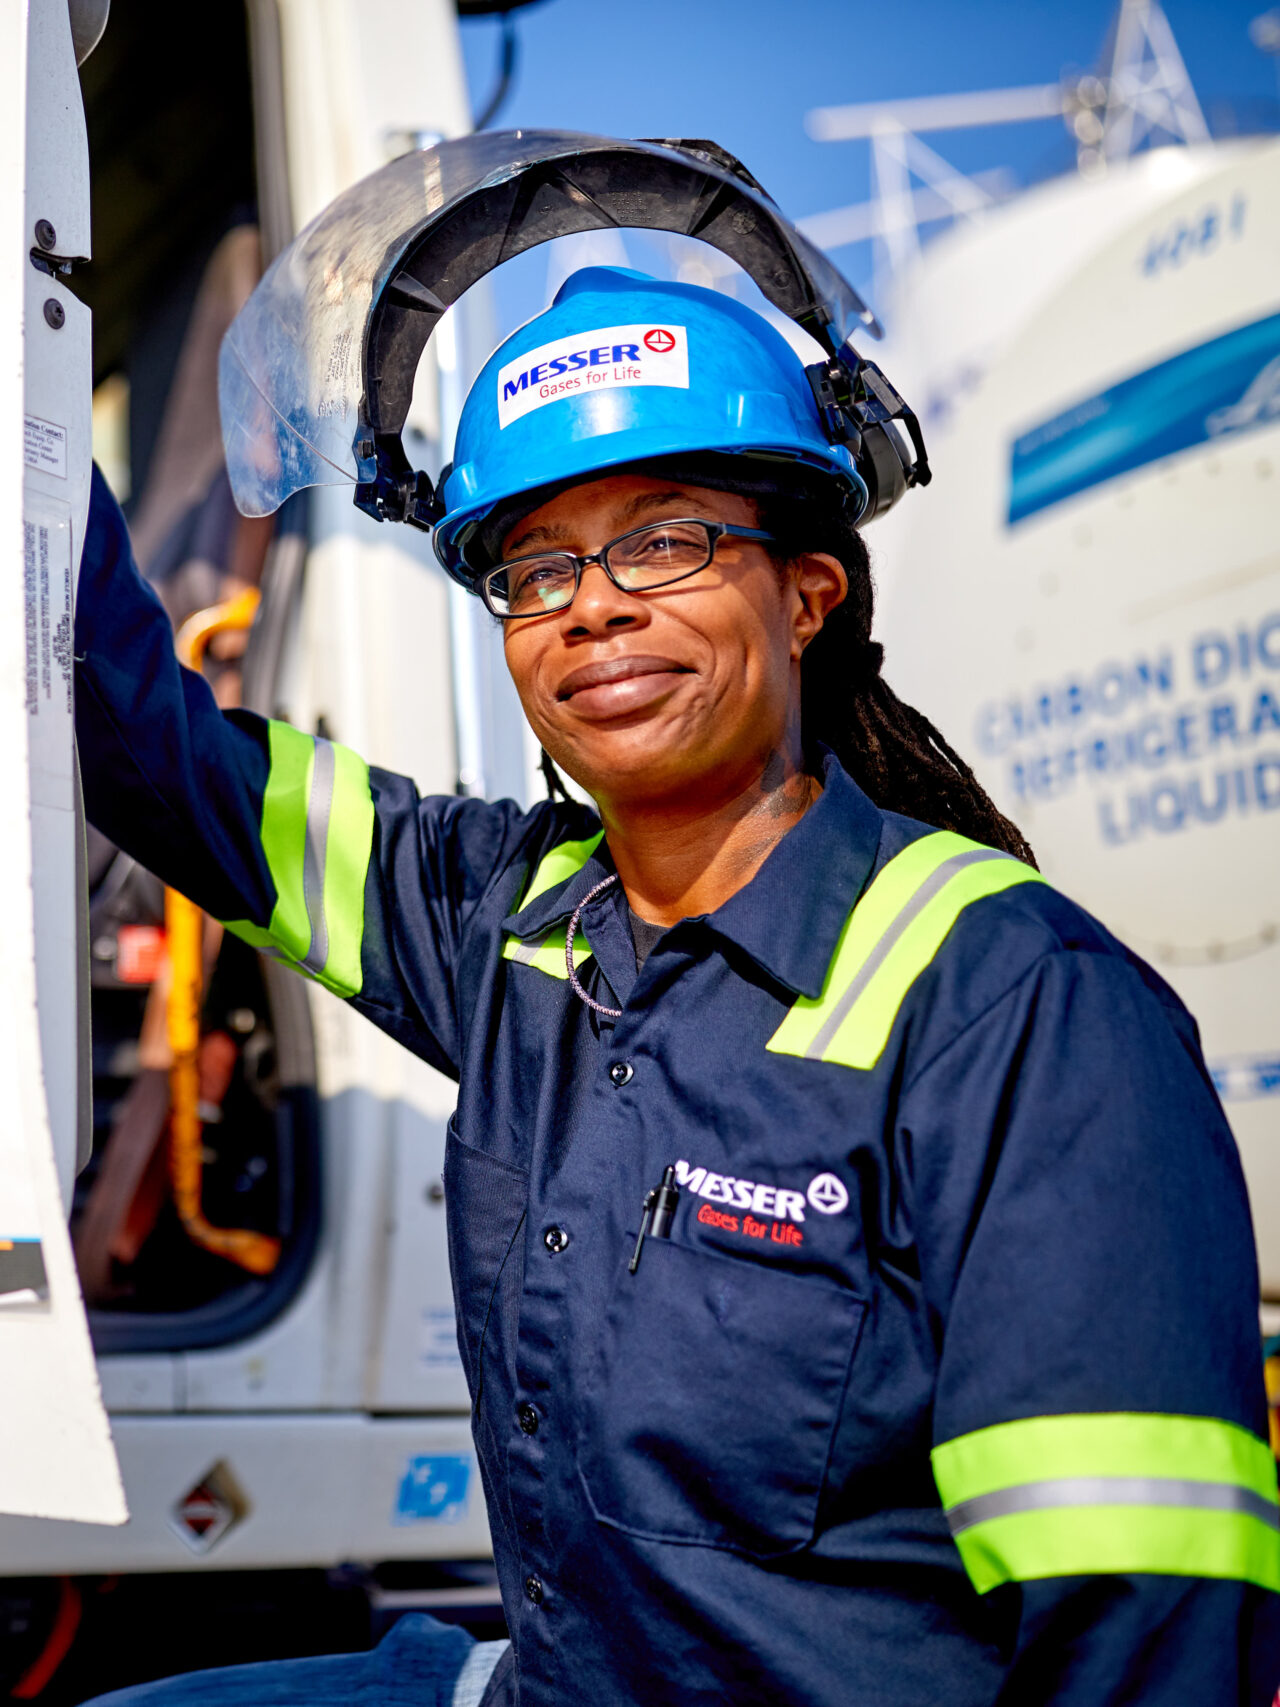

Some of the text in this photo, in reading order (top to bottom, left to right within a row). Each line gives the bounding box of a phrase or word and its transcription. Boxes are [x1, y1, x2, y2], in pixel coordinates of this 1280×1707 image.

[503, 344, 641, 402] MESSER
[539, 366, 641, 399] Gases for Life
[674, 1159, 806, 1222] MESSER
[697, 1204, 803, 1247] Gases for Life
